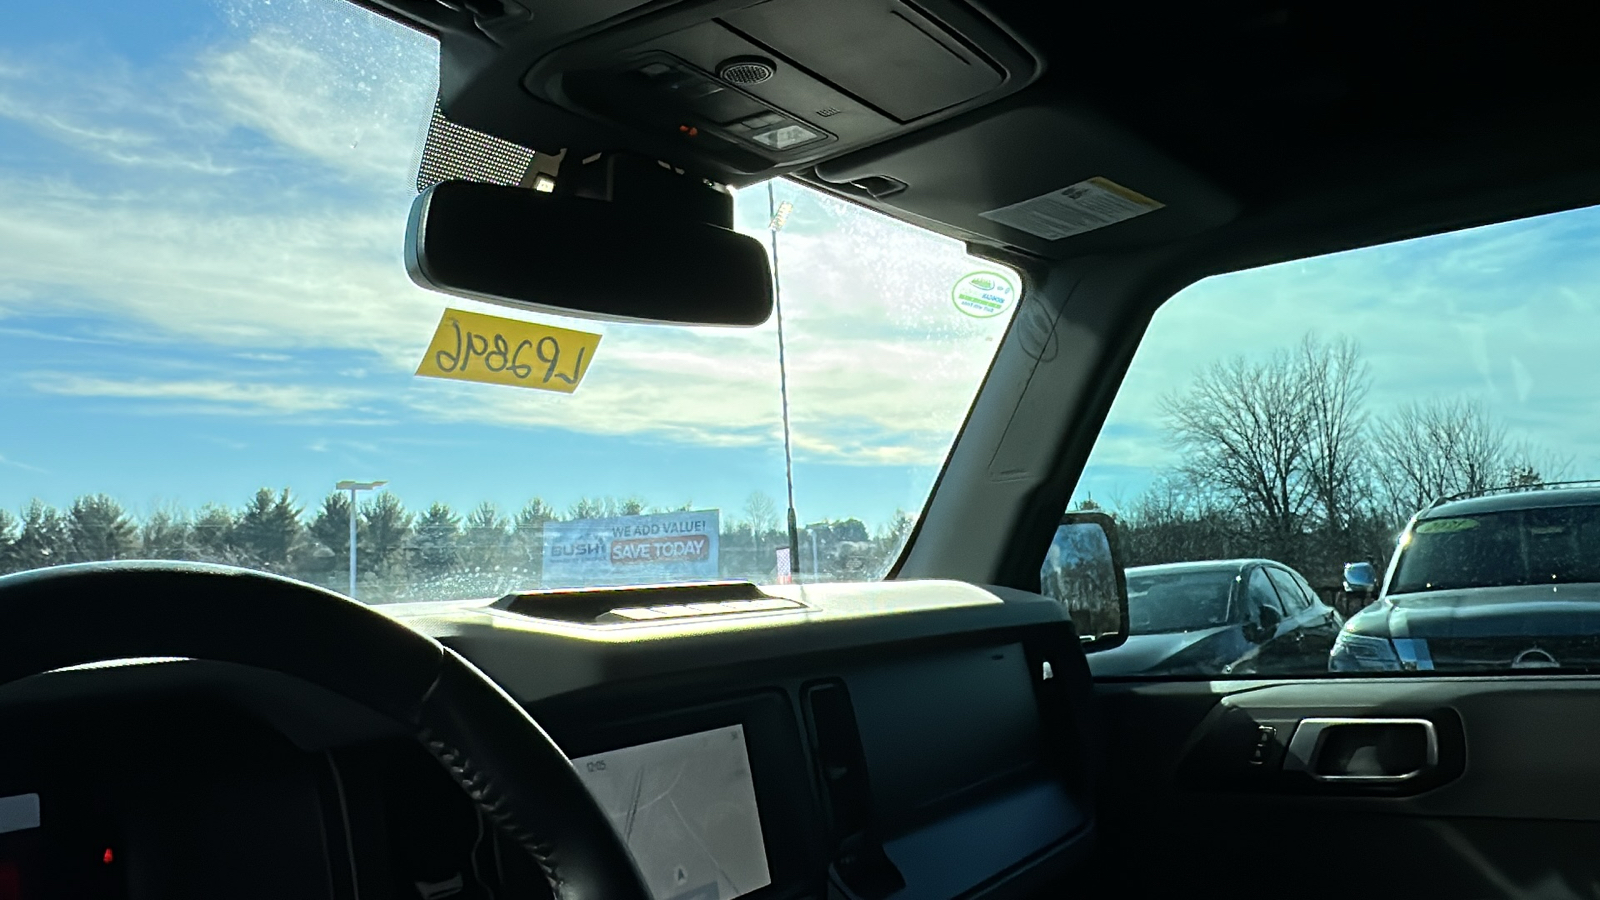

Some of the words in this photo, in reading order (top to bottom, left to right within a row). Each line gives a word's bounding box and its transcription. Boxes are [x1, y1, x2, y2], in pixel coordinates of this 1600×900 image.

[611, 525, 631, 538] WE
[634, 524, 660, 536] ADD
[663, 520, 706, 534] VALUE!
[612, 542, 650, 561] SAVE
[655, 540, 705, 558] TODAY
